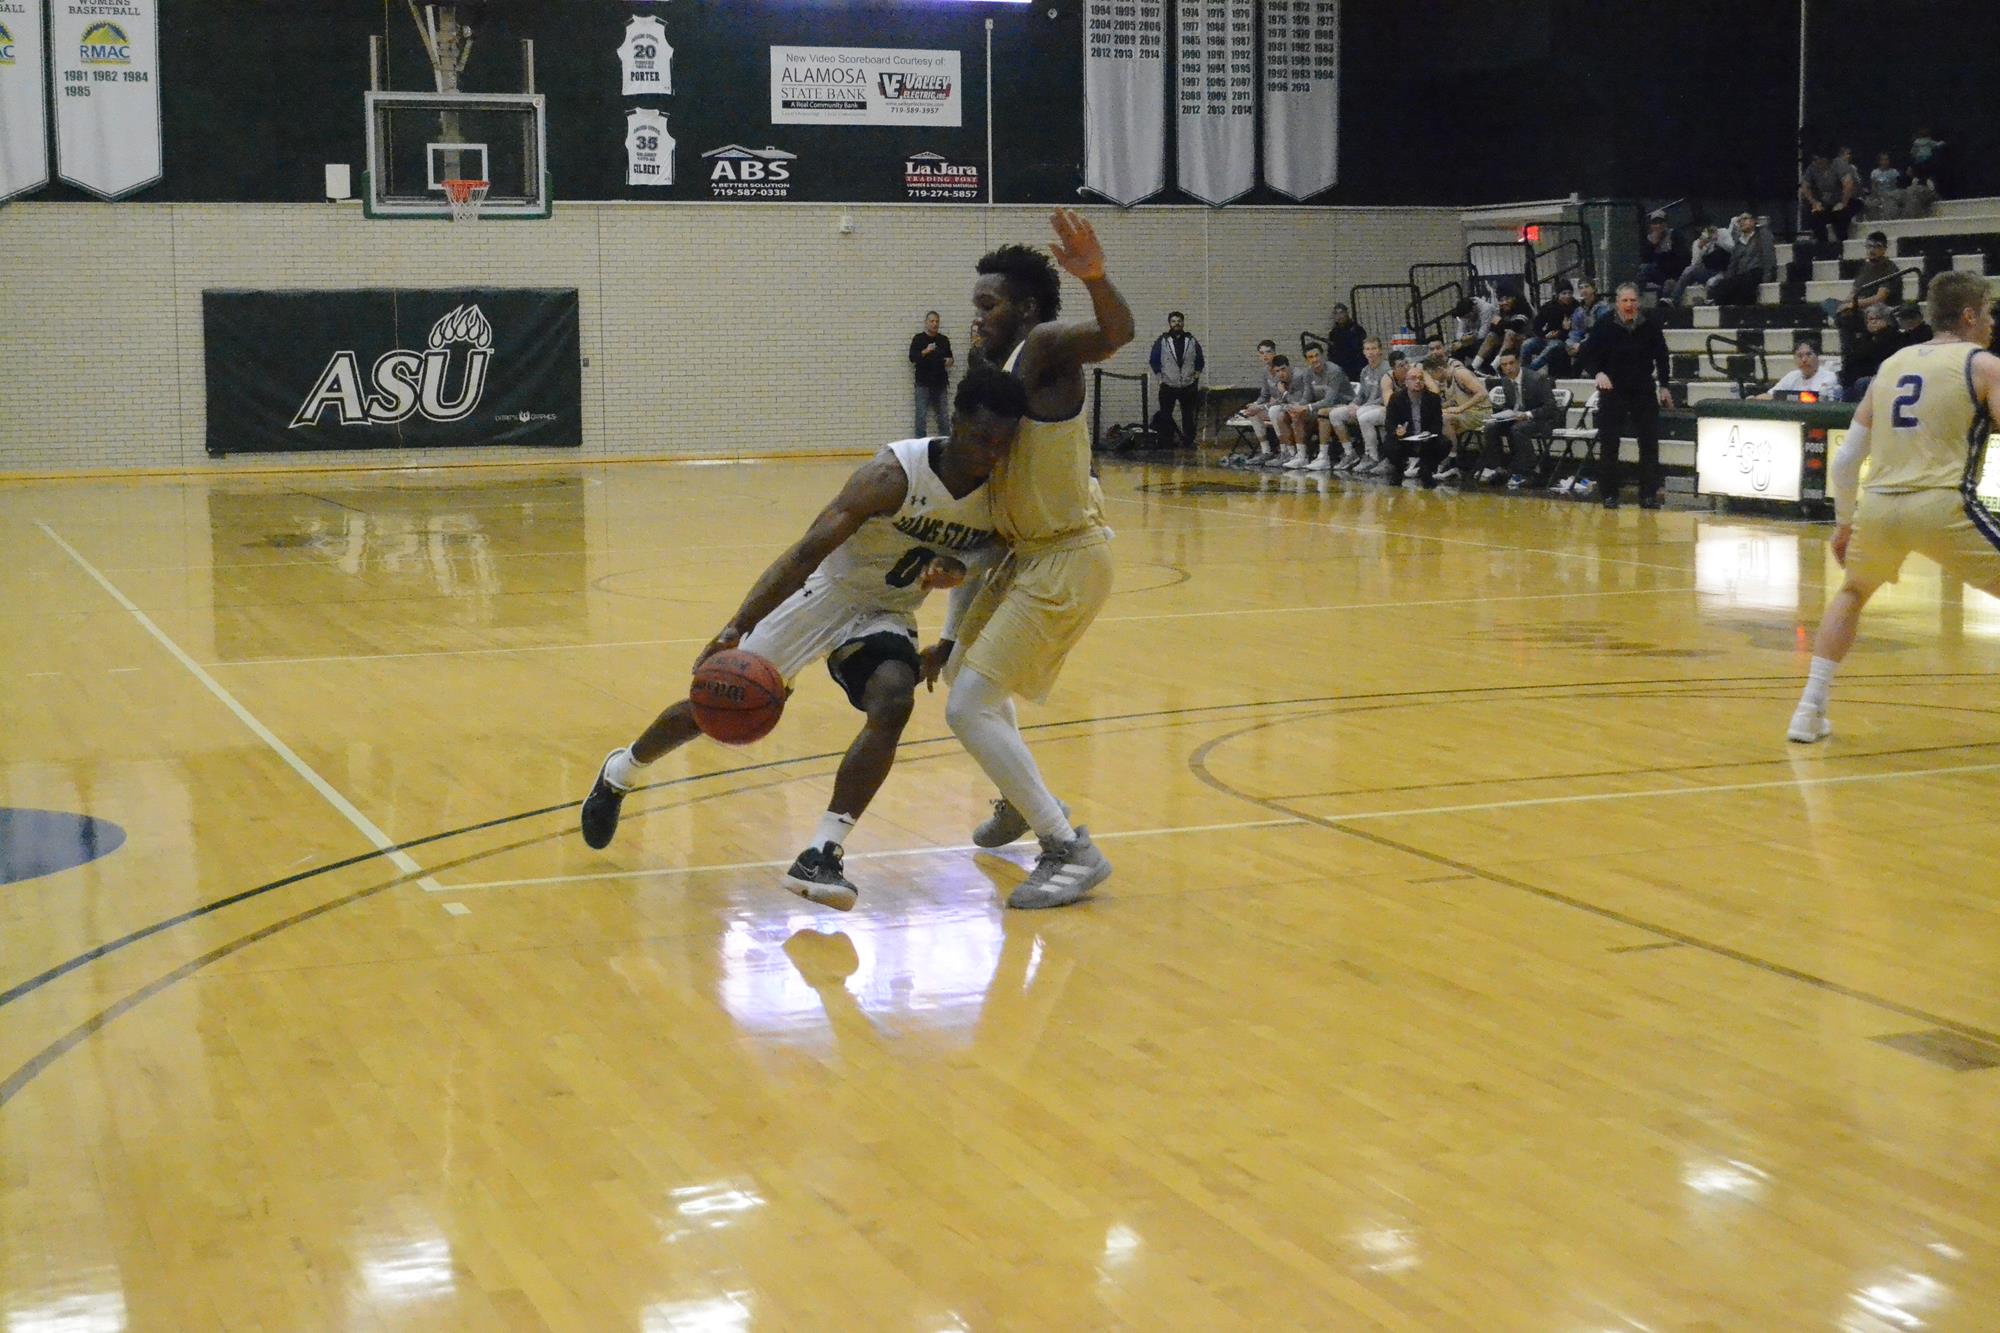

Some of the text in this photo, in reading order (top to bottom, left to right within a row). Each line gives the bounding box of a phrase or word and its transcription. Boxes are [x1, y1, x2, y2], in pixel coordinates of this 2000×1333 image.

[68, 6, 141, 16] BASKETBALL
[80, 45, 130, 59] RMAC
[634, 45, 656, 59] 20
[1091, 47, 1111, 58] 2012
[1139, 49, 1160, 59] 2014
[786, 53, 807, 63] New
[809, 54, 836, 63] Video
[838, 54, 891, 65] Scoreboard
[893, 56, 933, 67] Courtesy
[64, 70, 148, 83] 1981 1982 1984
[630, 71, 660, 82] PORTER
[781, 67, 867, 84] ALAMOSA
[903, 73, 951, 90] VALLEY
[64, 86, 91, 97] 1985
[781, 87, 866, 100] STATE BANK
[1182, 105, 1201, 114] 2012
[633, 164, 661, 175] GILBERT
[710, 160, 790, 181] ABS
[905, 162, 978, 176] La Jara
[908, 189, 978, 198] 719-274-5857
[288, 348, 495, 429] ASU
[1892, 374, 1923, 428] 2
[885, 546, 936, 588] 0
